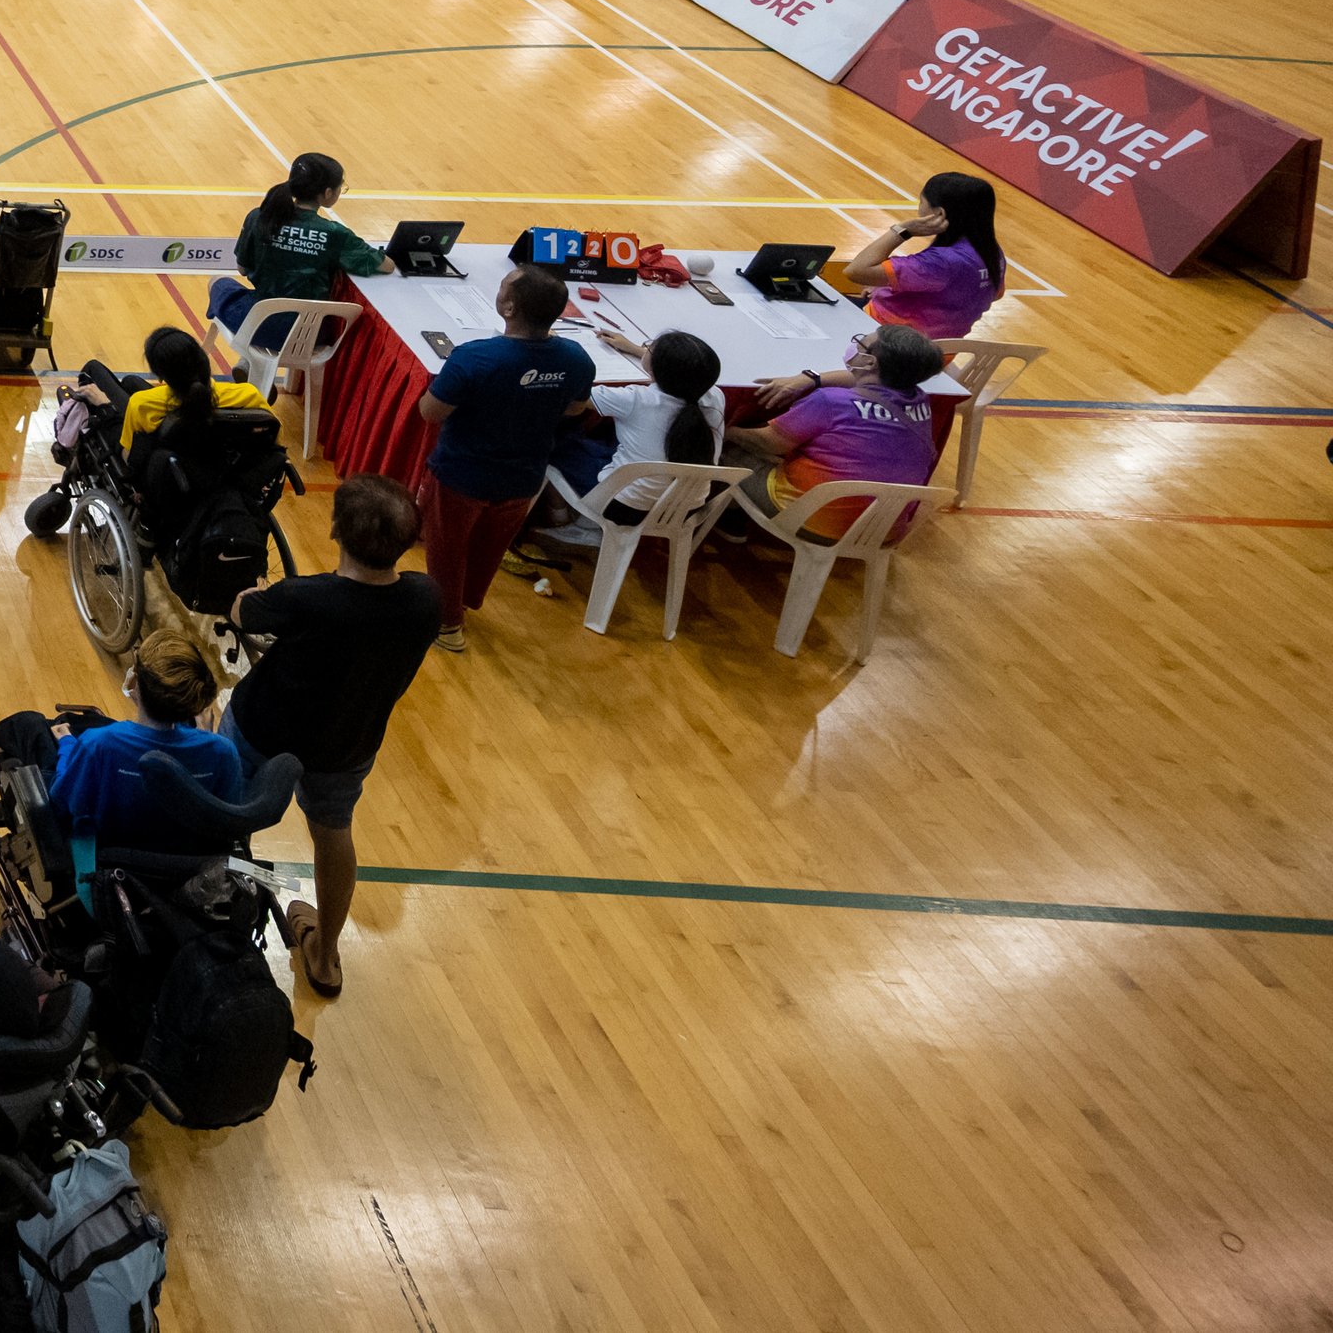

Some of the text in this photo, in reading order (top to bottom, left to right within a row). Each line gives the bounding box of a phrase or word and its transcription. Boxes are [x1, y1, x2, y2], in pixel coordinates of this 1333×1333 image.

[906, 63, 1137, 197] SINGAPORE
[280, 225, 328, 243] FFLES
[287, 238, 326, 251] SCHOOL
[542, 232, 637, 266] 1 2 2 0
[90, 248, 125, 259] SDSC
[187, 249, 222, 260] SDSC
[293, 247, 318, 256] DRAMA
[537, 372, 566, 381] SDSC
